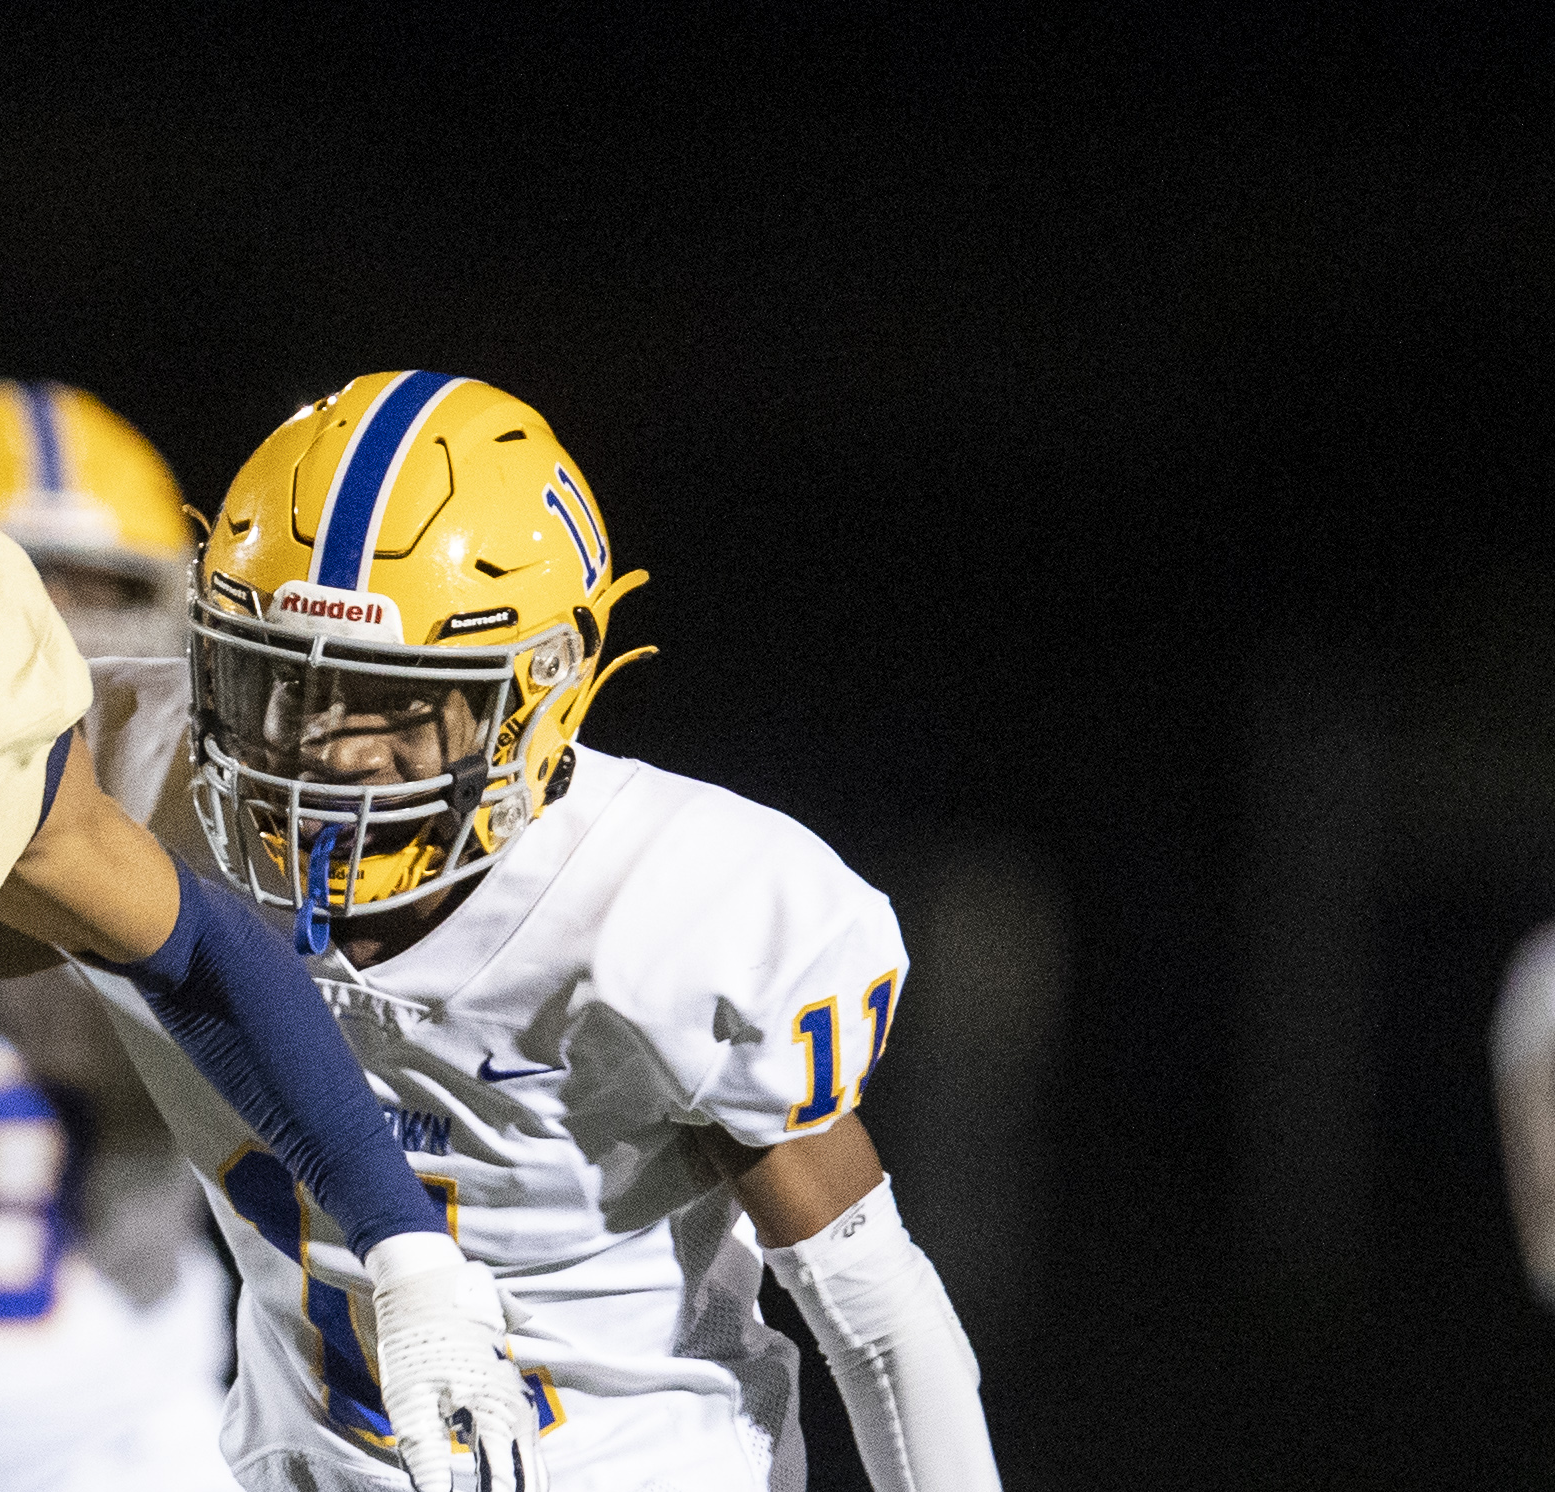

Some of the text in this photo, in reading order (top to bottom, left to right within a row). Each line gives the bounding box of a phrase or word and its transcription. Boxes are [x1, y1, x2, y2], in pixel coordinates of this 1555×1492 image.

[541, 461, 608, 598] 11
[281, 592, 382, 624] Riddell
[784, 967, 898, 1132] 11
